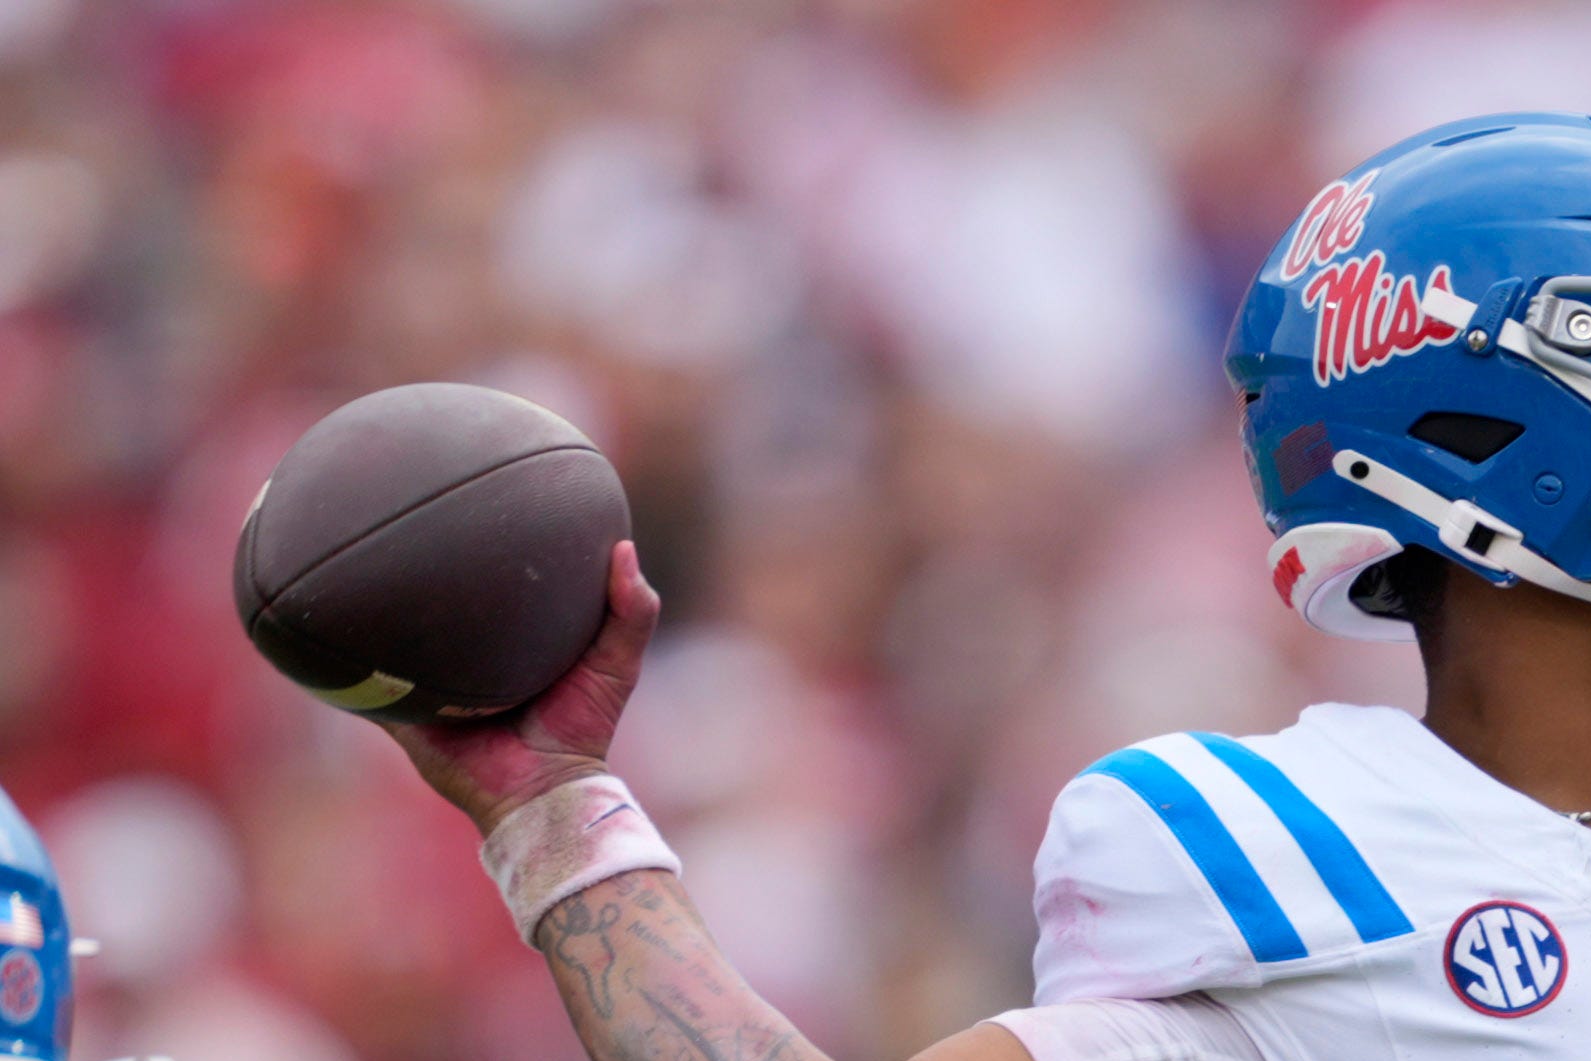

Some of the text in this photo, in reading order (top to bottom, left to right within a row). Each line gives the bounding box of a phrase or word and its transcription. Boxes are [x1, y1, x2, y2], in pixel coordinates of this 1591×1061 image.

[1280, 167, 1380, 281] Ole
[1302, 250, 1460, 387] Miss
[1452, 907, 1560, 1010] SEC
